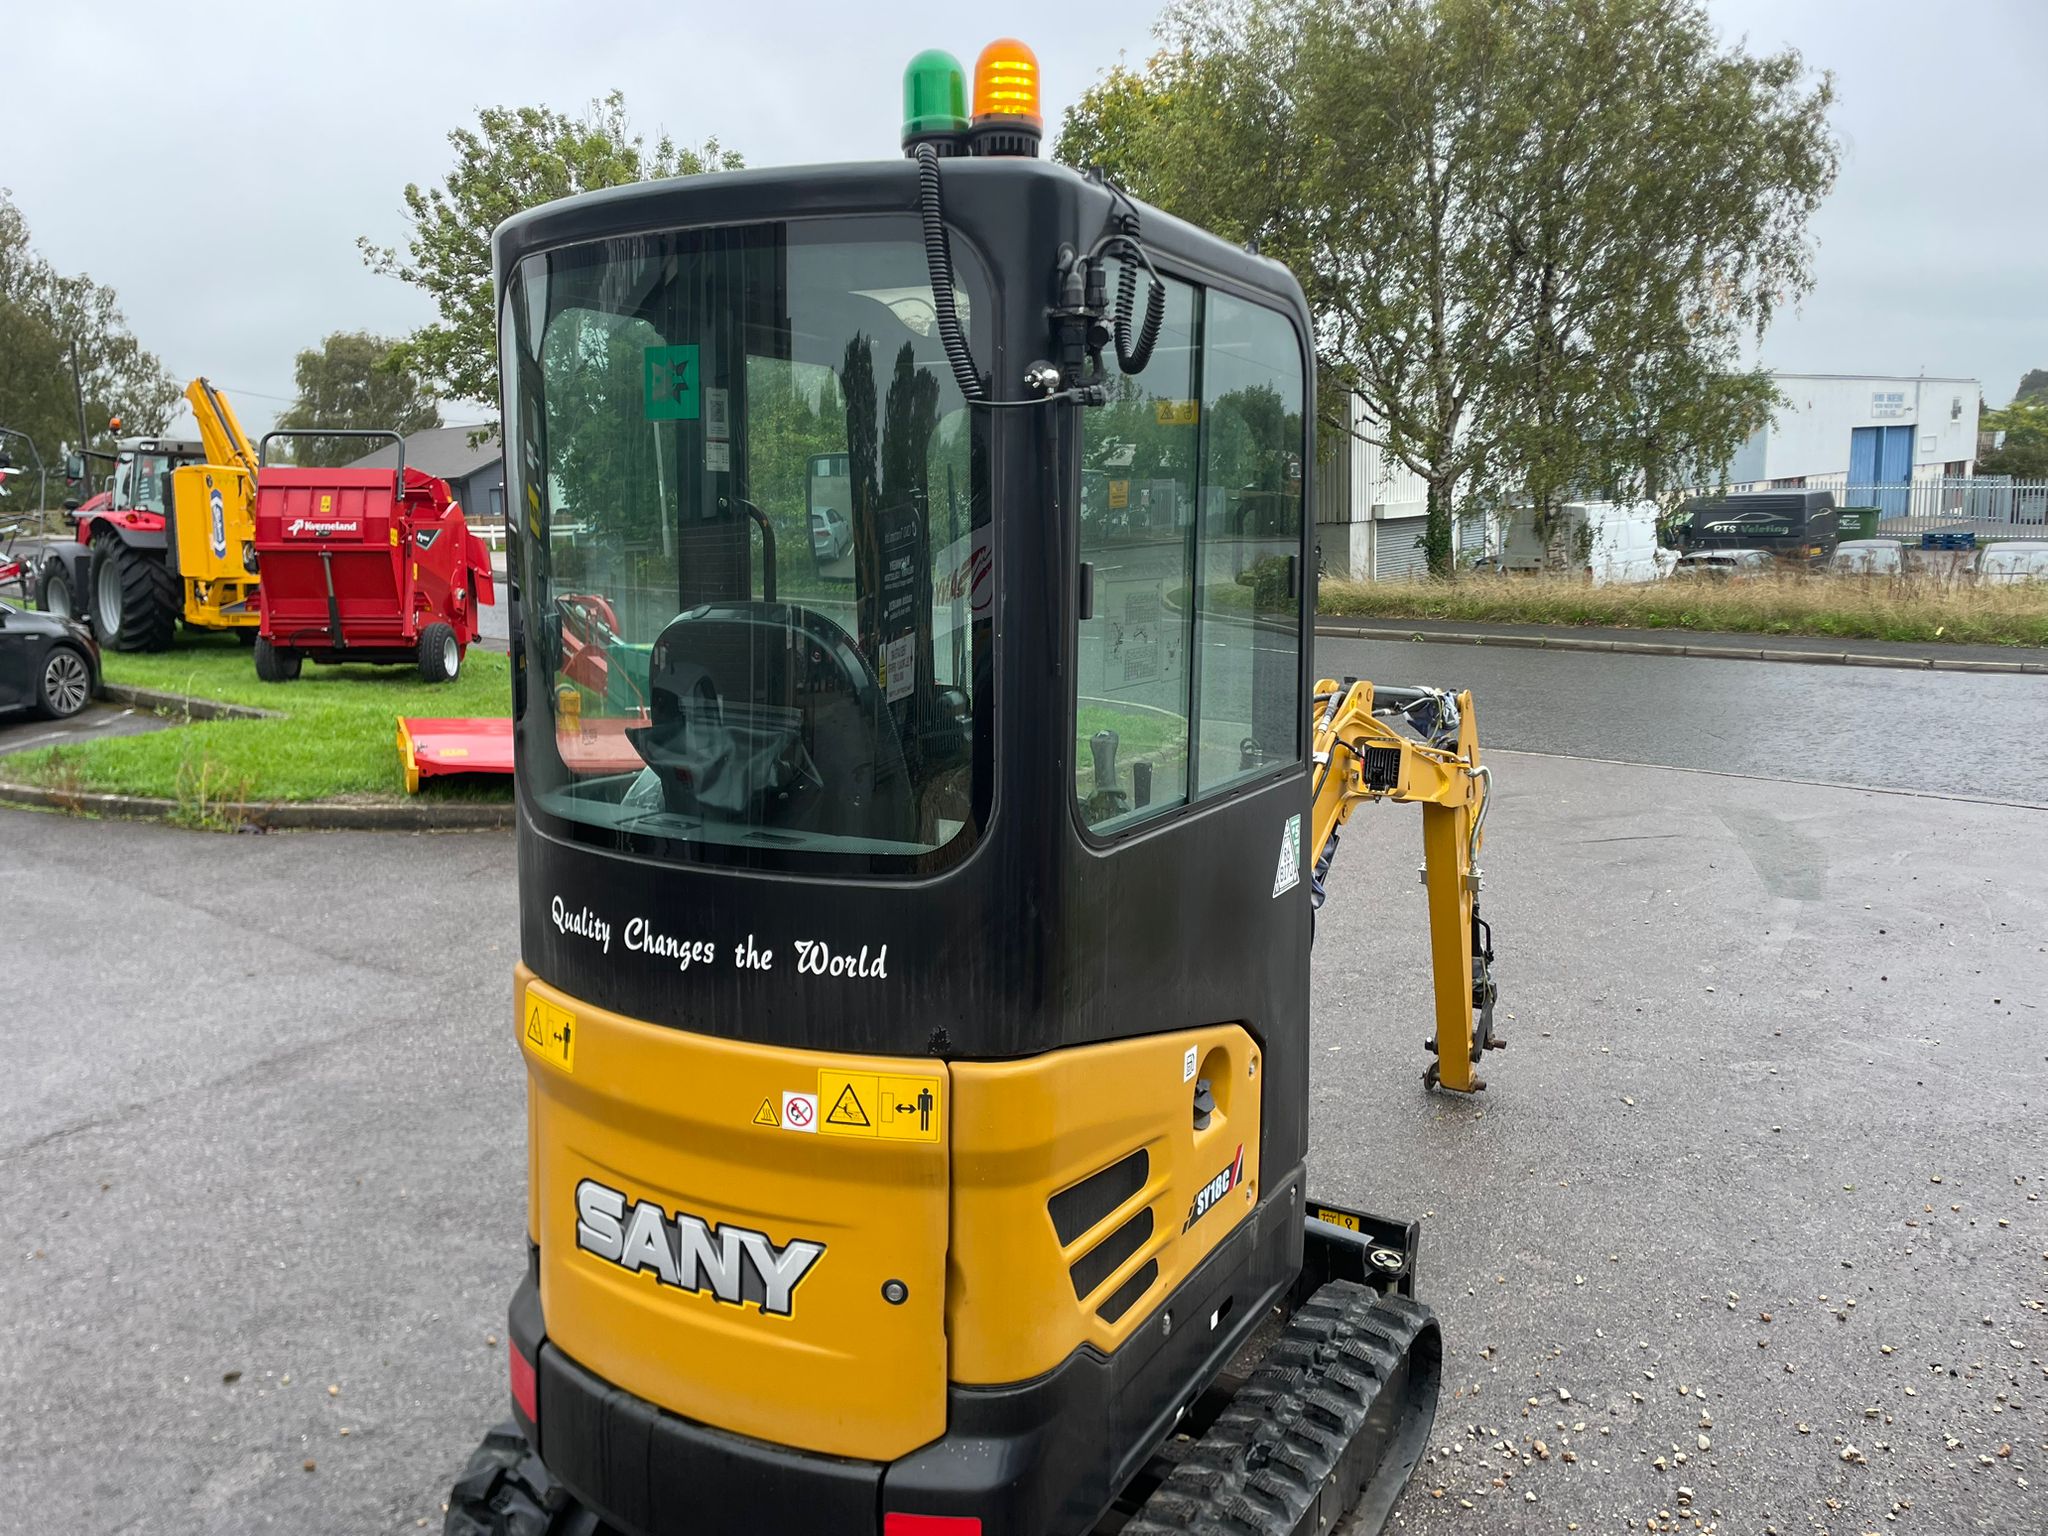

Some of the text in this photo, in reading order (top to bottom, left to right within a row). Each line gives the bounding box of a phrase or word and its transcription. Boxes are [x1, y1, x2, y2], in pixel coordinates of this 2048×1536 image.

[304, 521, 357, 532] Kverneland
[1713, 524, 1737, 534] RTS
[551, 895, 888, 979] Quality Changes the World
[1197, 1169, 1230, 1215] SY18C
[577, 1180, 826, 1316] SANY
